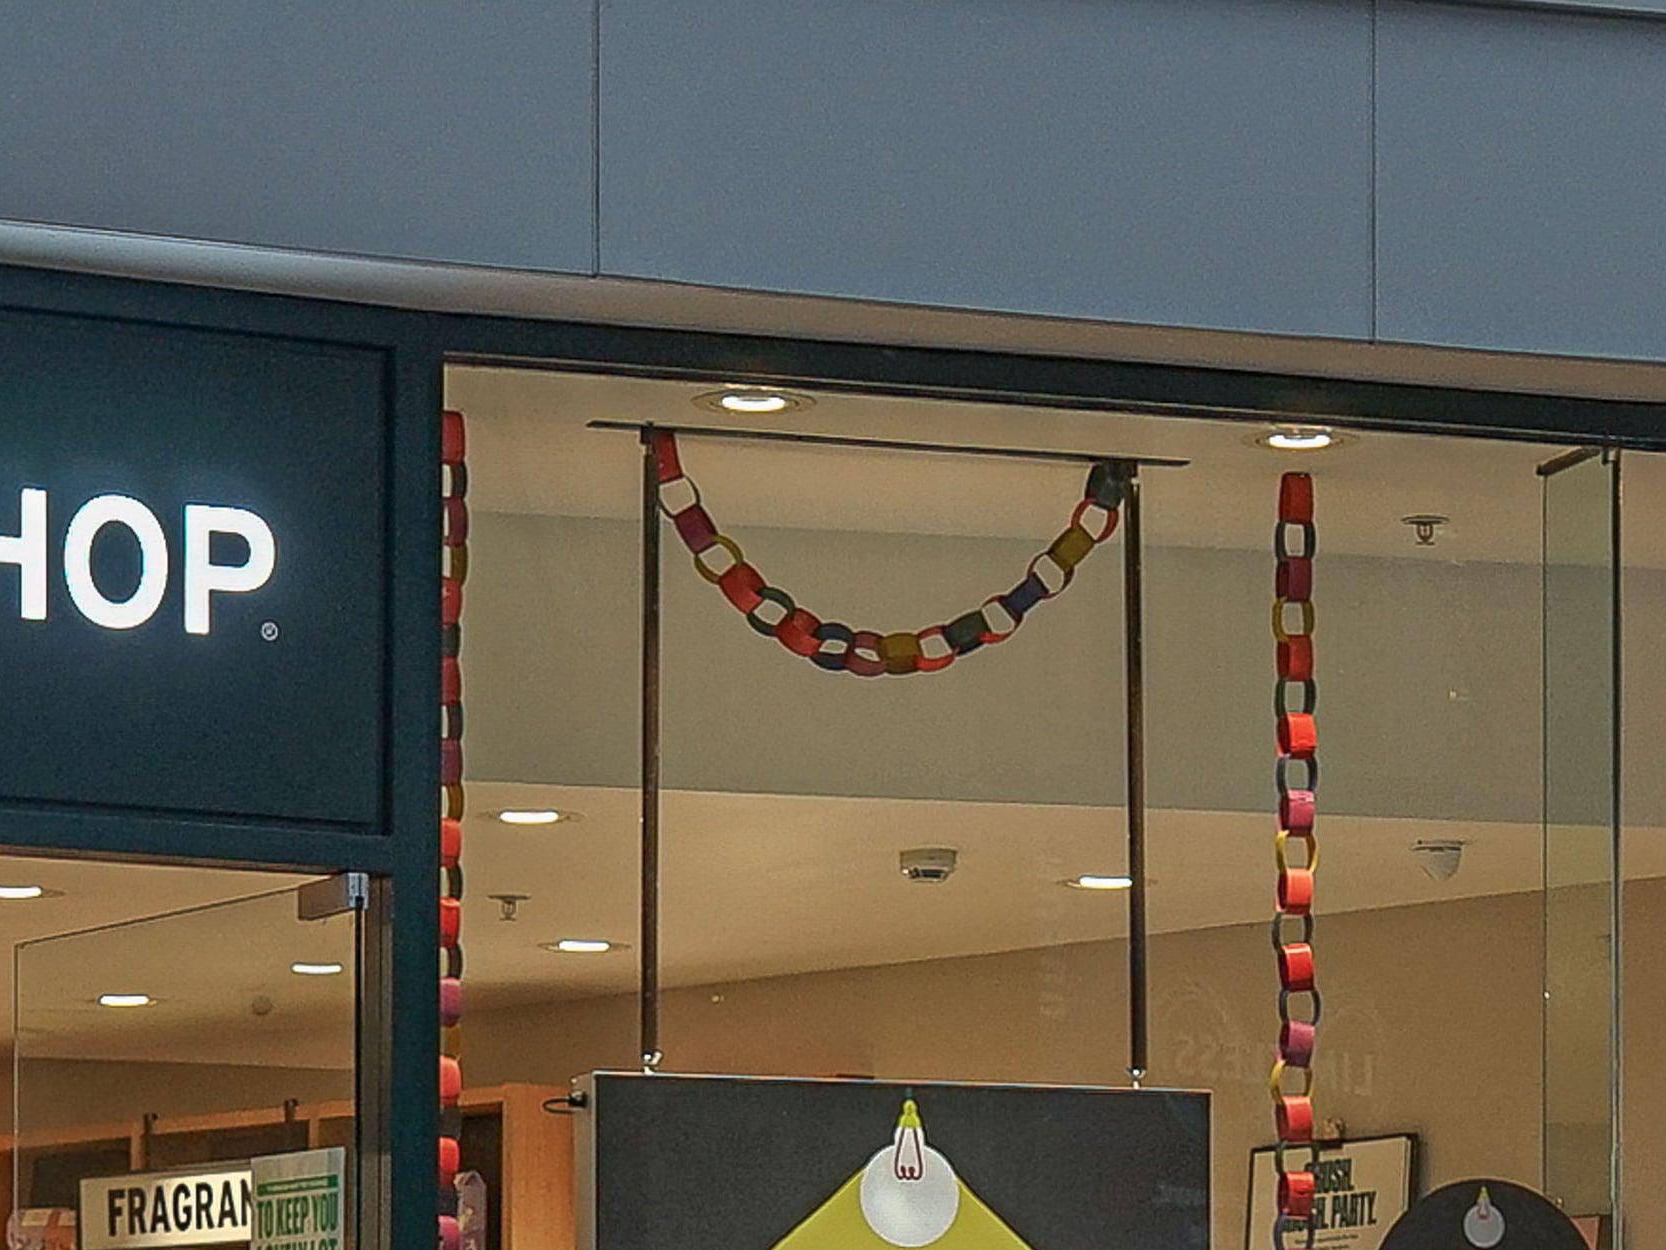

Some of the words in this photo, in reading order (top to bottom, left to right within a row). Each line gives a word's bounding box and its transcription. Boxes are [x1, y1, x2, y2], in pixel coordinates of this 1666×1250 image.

[256, 1202, 273, 1239] TO
[276, 1196, 309, 1237] KEEP
[313, 1193, 338, 1233] YOU
